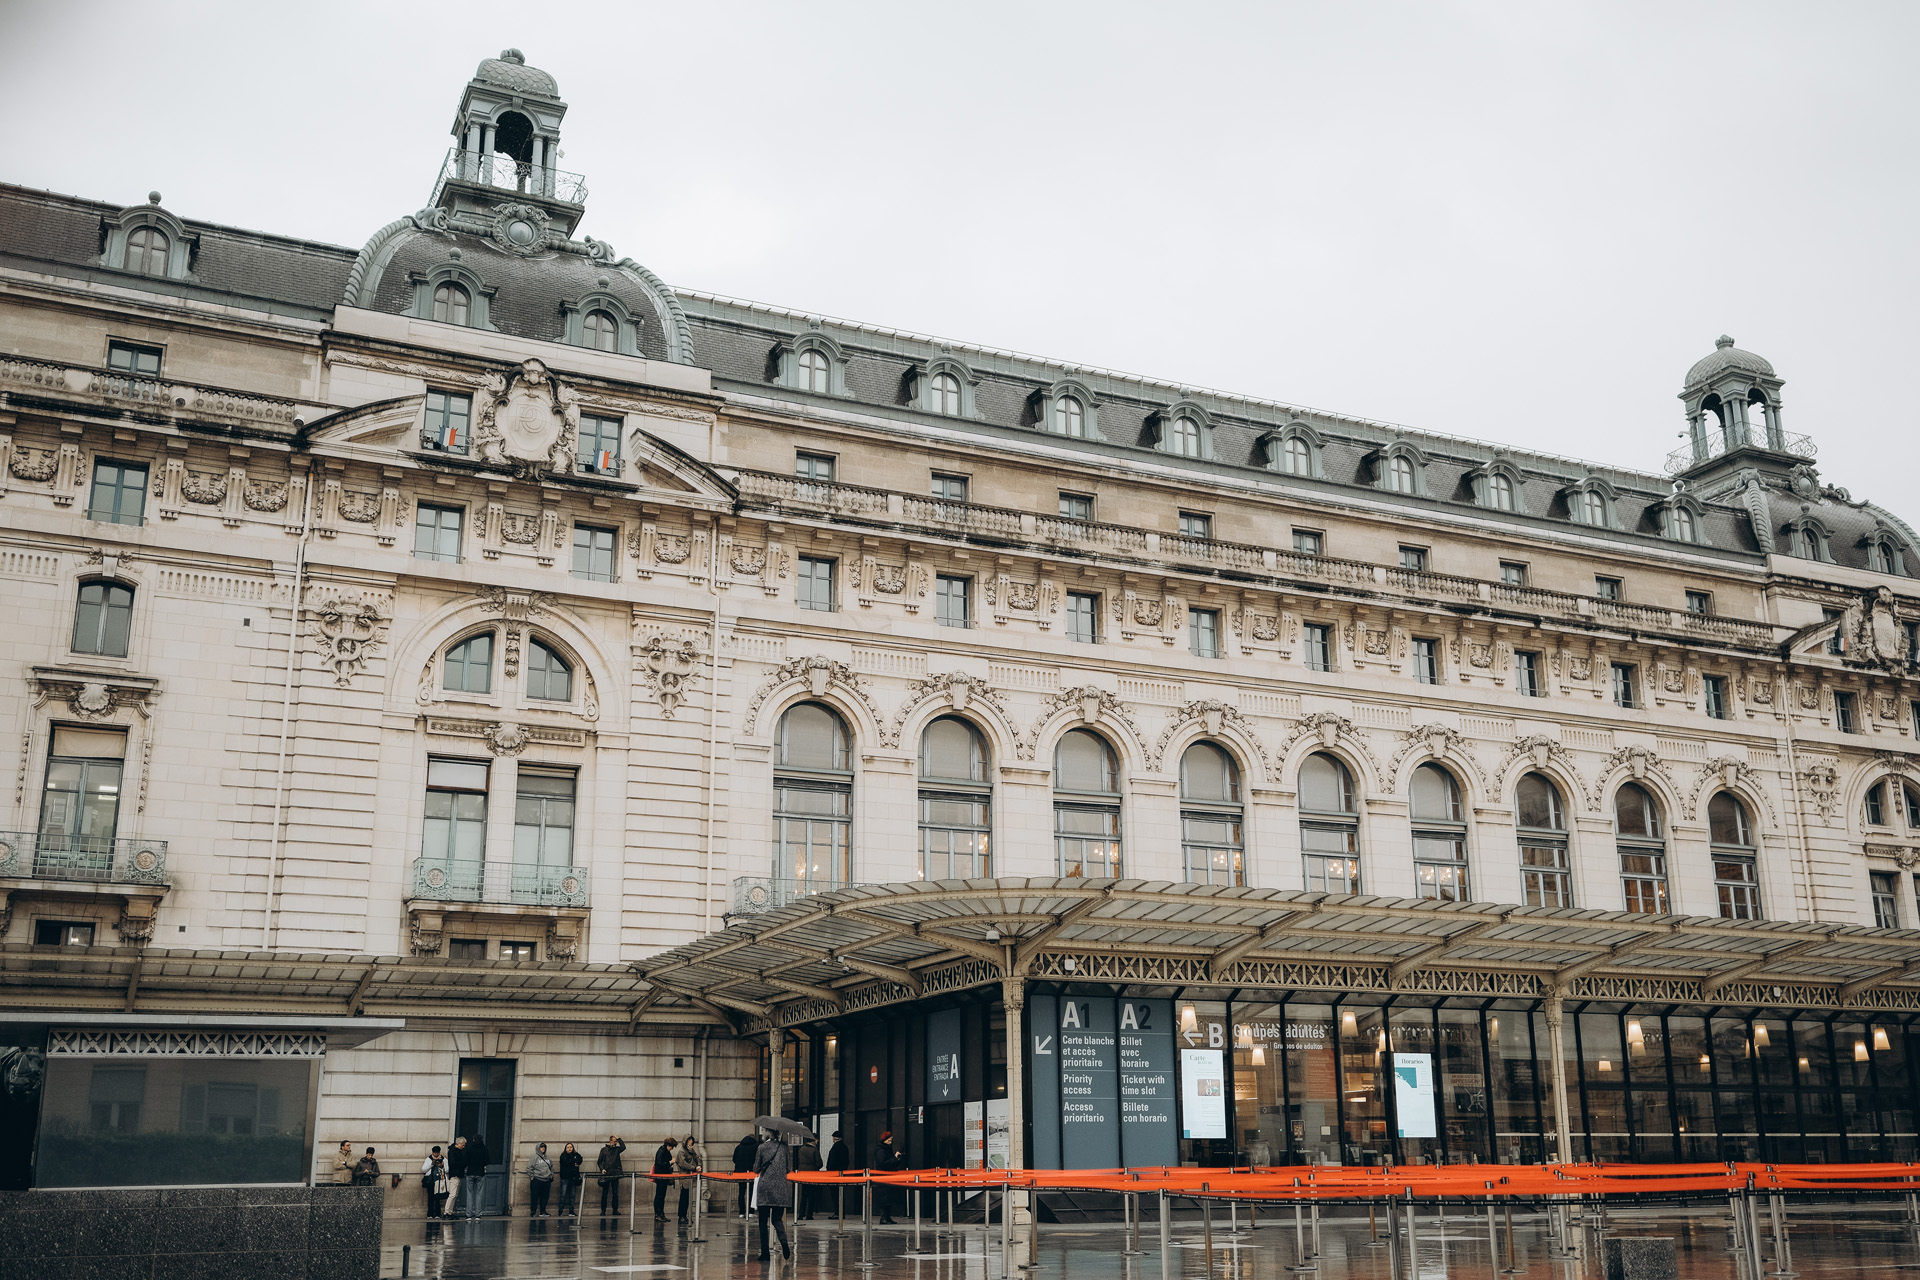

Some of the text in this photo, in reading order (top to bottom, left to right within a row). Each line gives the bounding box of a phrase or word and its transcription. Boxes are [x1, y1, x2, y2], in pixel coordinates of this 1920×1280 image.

[1209, 1022, 1224, 1048] B
[1285, 1023, 1325, 1039] adultes
[1062, 1035, 1115, 1046] Carte blanche
[1120, 1036, 1143, 1046] Billet
[1295, 1042, 1303, 1050] de
[1062, 1046, 1097, 1056] et accès
[1121, 1049, 1140, 1057] avec
[949, 1053, 959, 1080] A
[1062, 1057, 1103, 1069] prioritaire
[1121, 1058, 1150, 1068] horaire
[1063, 1073, 1093, 1086] Priority
[1121, 1074, 1166, 1085] Ticket with
[1063, 1086, 1092, 1095] access
[1122, 1085, 1157, 1095] time slot
[1063, 1101, 1094, 1112] Acceso
[1122, 1102, 1149, 1112] Billete
[1064, 1112, 1105, 1125] prioritario
[1123, 1112, 1168, 1123] con horario
